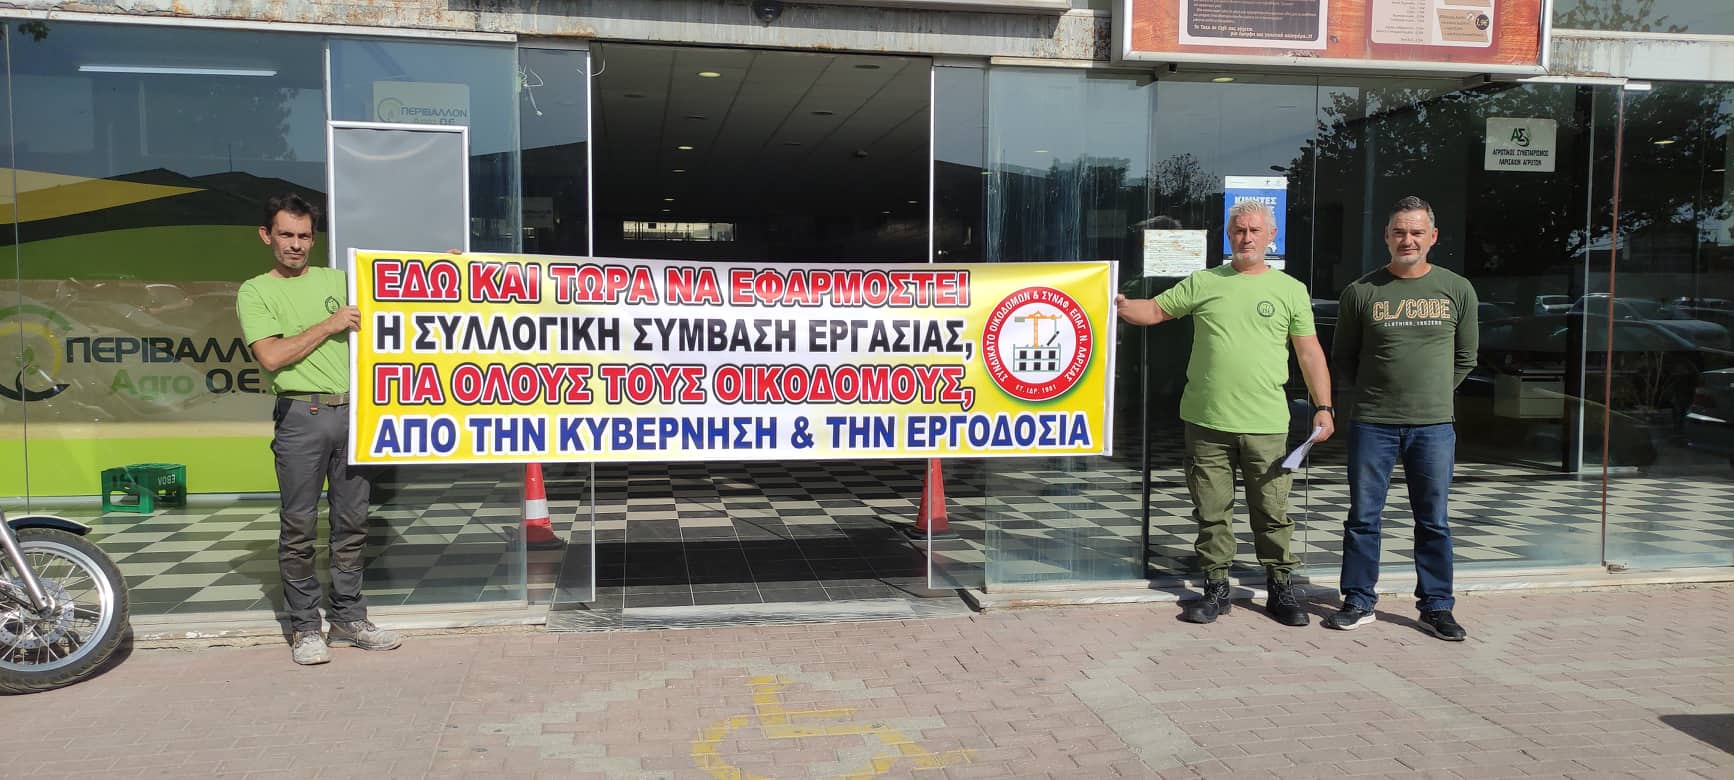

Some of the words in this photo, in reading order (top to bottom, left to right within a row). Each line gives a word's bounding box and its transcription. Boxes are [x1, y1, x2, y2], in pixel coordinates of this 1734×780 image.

[400, 107, 467, 118] ΠΕΡΙΒΑΛΛΟΝ
[374, 262, 460, 301] ΕΔΩ
[470, 263, 541, 302] ΚΑΙ
[550, 265, 659, 304] ΤΩΡΑ
[665, 266, 722, 306] ΝΑ
[729, 268, 970, 307] ΕΦΑΡΜΟΣΤΕΙ
[1033, 291, 1039, 300] &
[989, 291, 1031, 332] ΟΙΚΟΔΟΜΩΝ
[66, 336, 256, 363] ΠΕΡΙΒΑΛΛ
[377, 315, 401, 351] Η
[415, 316, 619, 351] ΣΥΛΛΟΓΙΚΗ
[633, 317, 798, 352] ΣΥΜΒΑΣΗ
[809, 319, 973, 360] ΕΡΓΑΣΙΑΣ,
[986, 334, 1009, 382] ΣΥΝΔΙΚΑΤΟ
[1064, 346, 1088, 383] ΛΑΡΙΣΑΣ
[112, 369, 194, 400] Agro
[373, 363, 445, 404] ΓΙΑ
[451, 364, 593, 404] ΟΛΟΥΣ
[599, 364, 706, 404] ΤΟΥΣ
[712, 364, 974, 411] ΟΙΚΟΔΟΜΟΥΣ,
[374, 417, 457, 453] ΑΠΟ
[469, 417, 546, 452] ΤΗΝ
[560, 416, 777, 451] ΚΥΒΕΡΝΗΣΗ
[790, 416, 814, 450] &
[826, 415, 895, 448] ΤΗΝ
[907, 413, 1091, 448] ΕΡΓΟΔΟΣΙΑ
